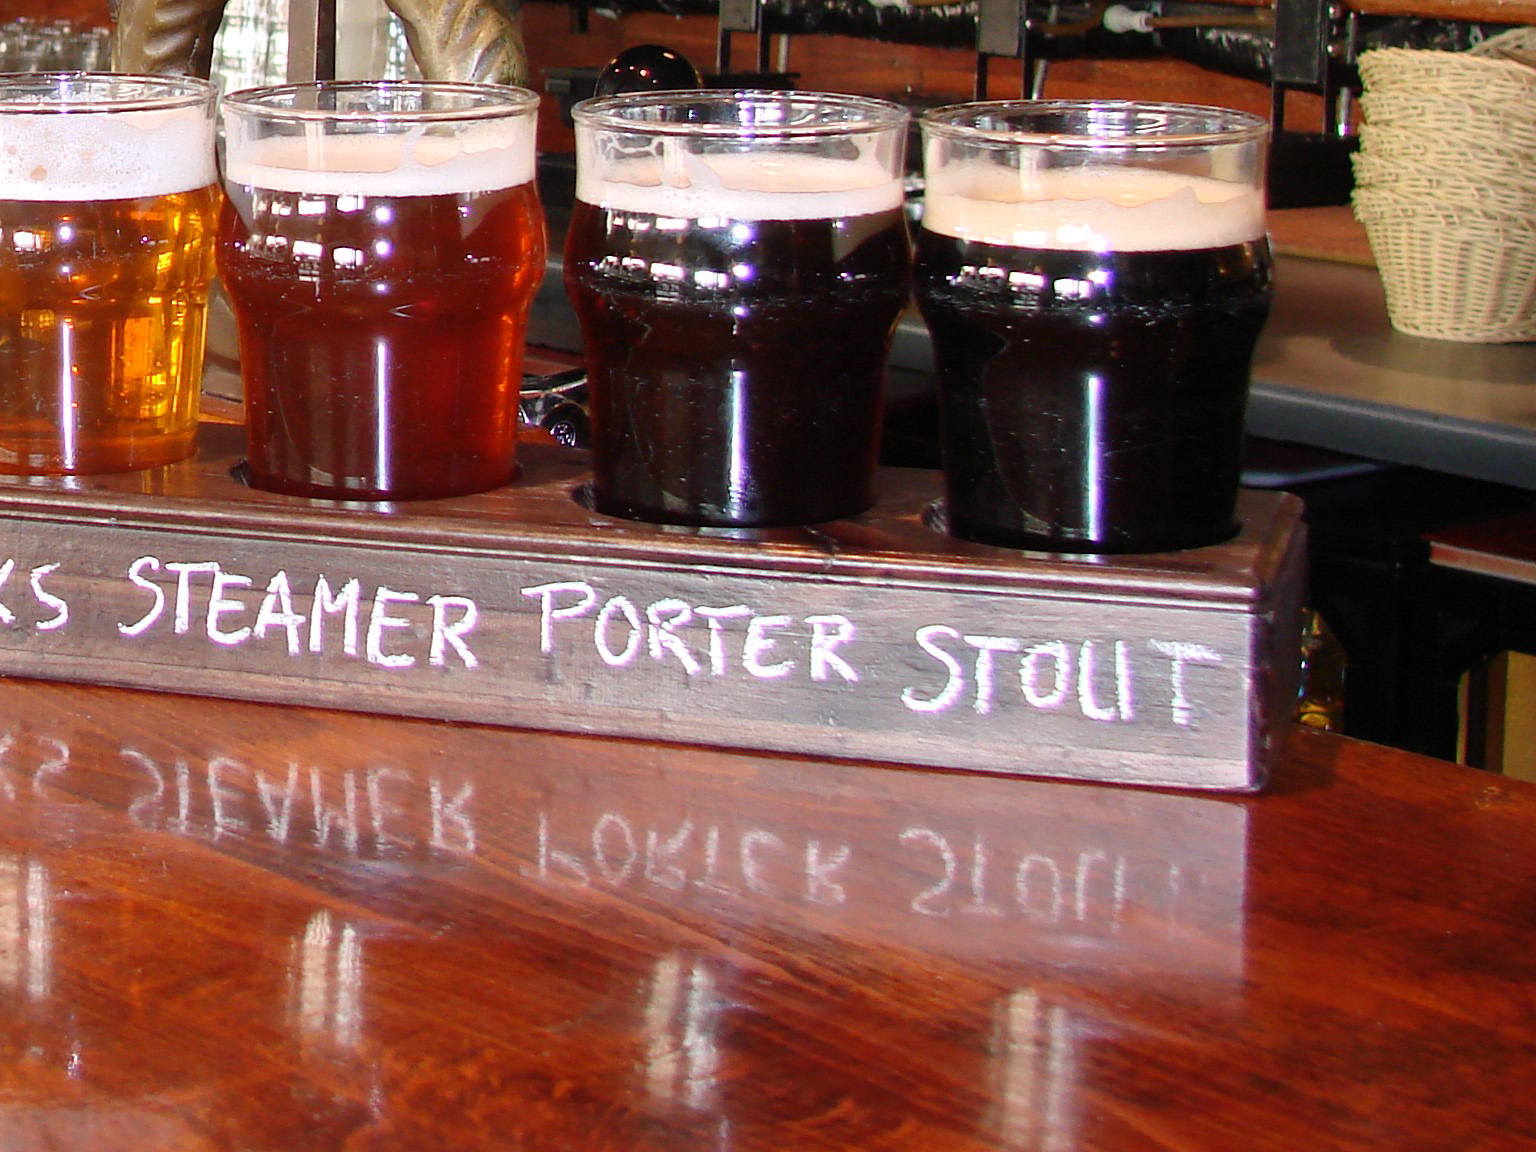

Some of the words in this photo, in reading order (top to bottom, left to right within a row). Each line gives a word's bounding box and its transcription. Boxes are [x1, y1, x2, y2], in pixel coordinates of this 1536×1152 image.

[117, 555, 480, 670] STEAMER
[520, 581, 859, 683] PORTER
[900, 623, 1220, 726] STOUT
